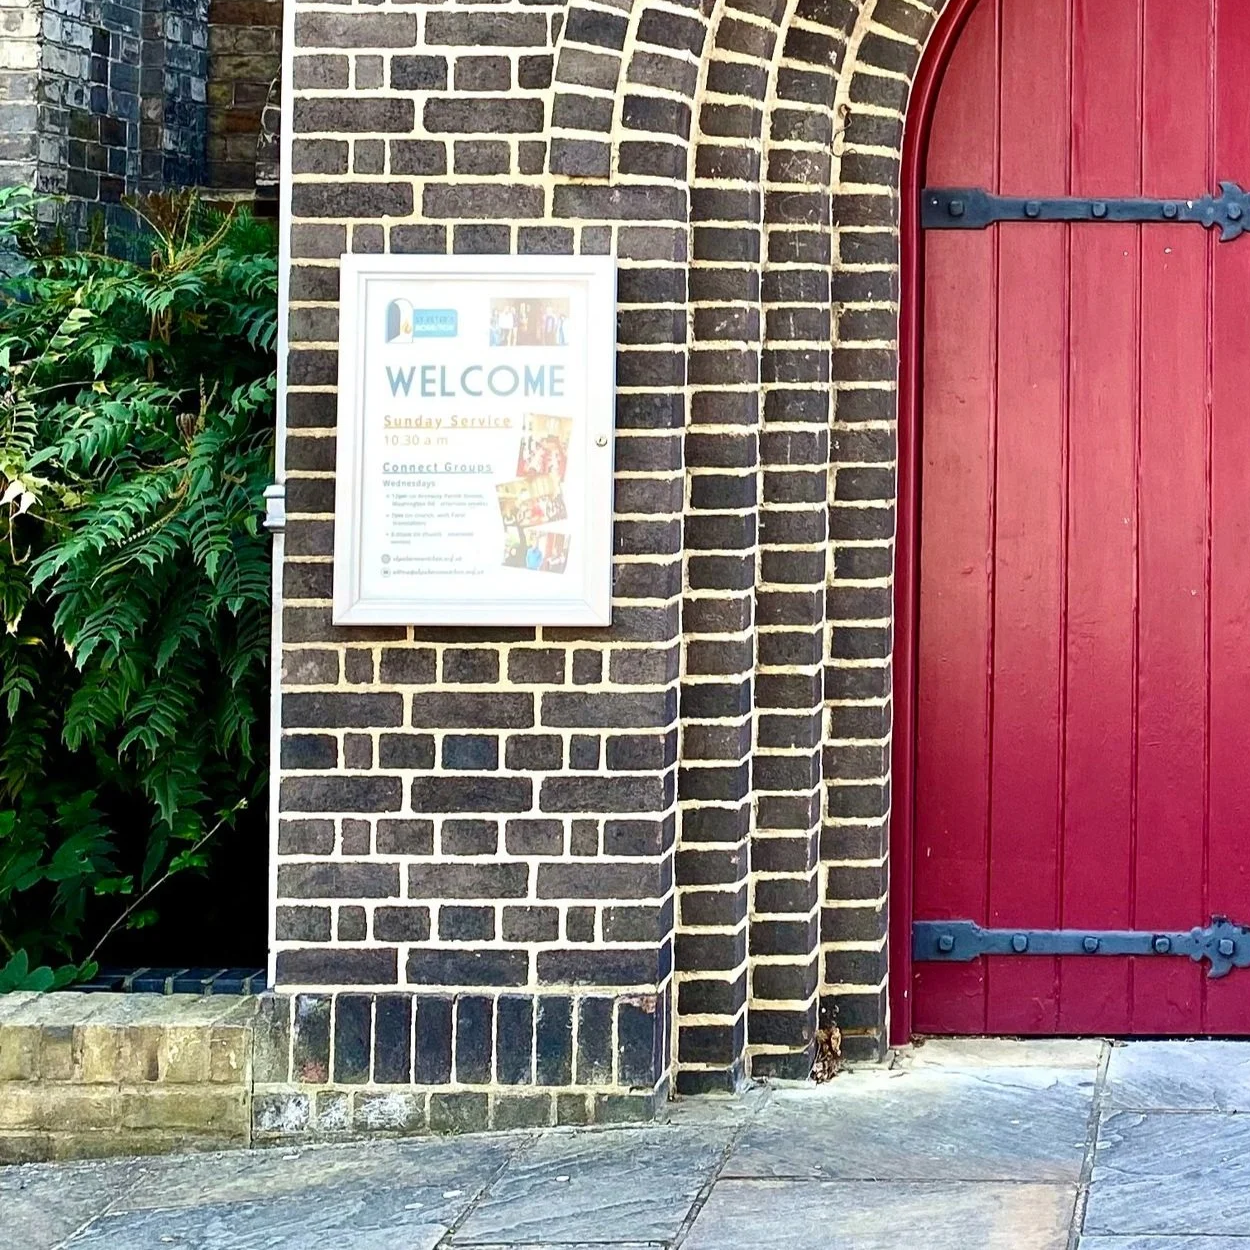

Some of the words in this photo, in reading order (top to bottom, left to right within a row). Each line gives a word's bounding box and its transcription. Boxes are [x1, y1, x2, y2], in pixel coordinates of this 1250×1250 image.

[385, 364, 564, 398] WELCOME
[384, 414, 443, 428] Sunday
[450, 414, 512, 427] Service
[382, 461, 438, 472] Connect
[444, 461, 493, 473] Groups
[382, 479, 436, 489] Wednesdays
